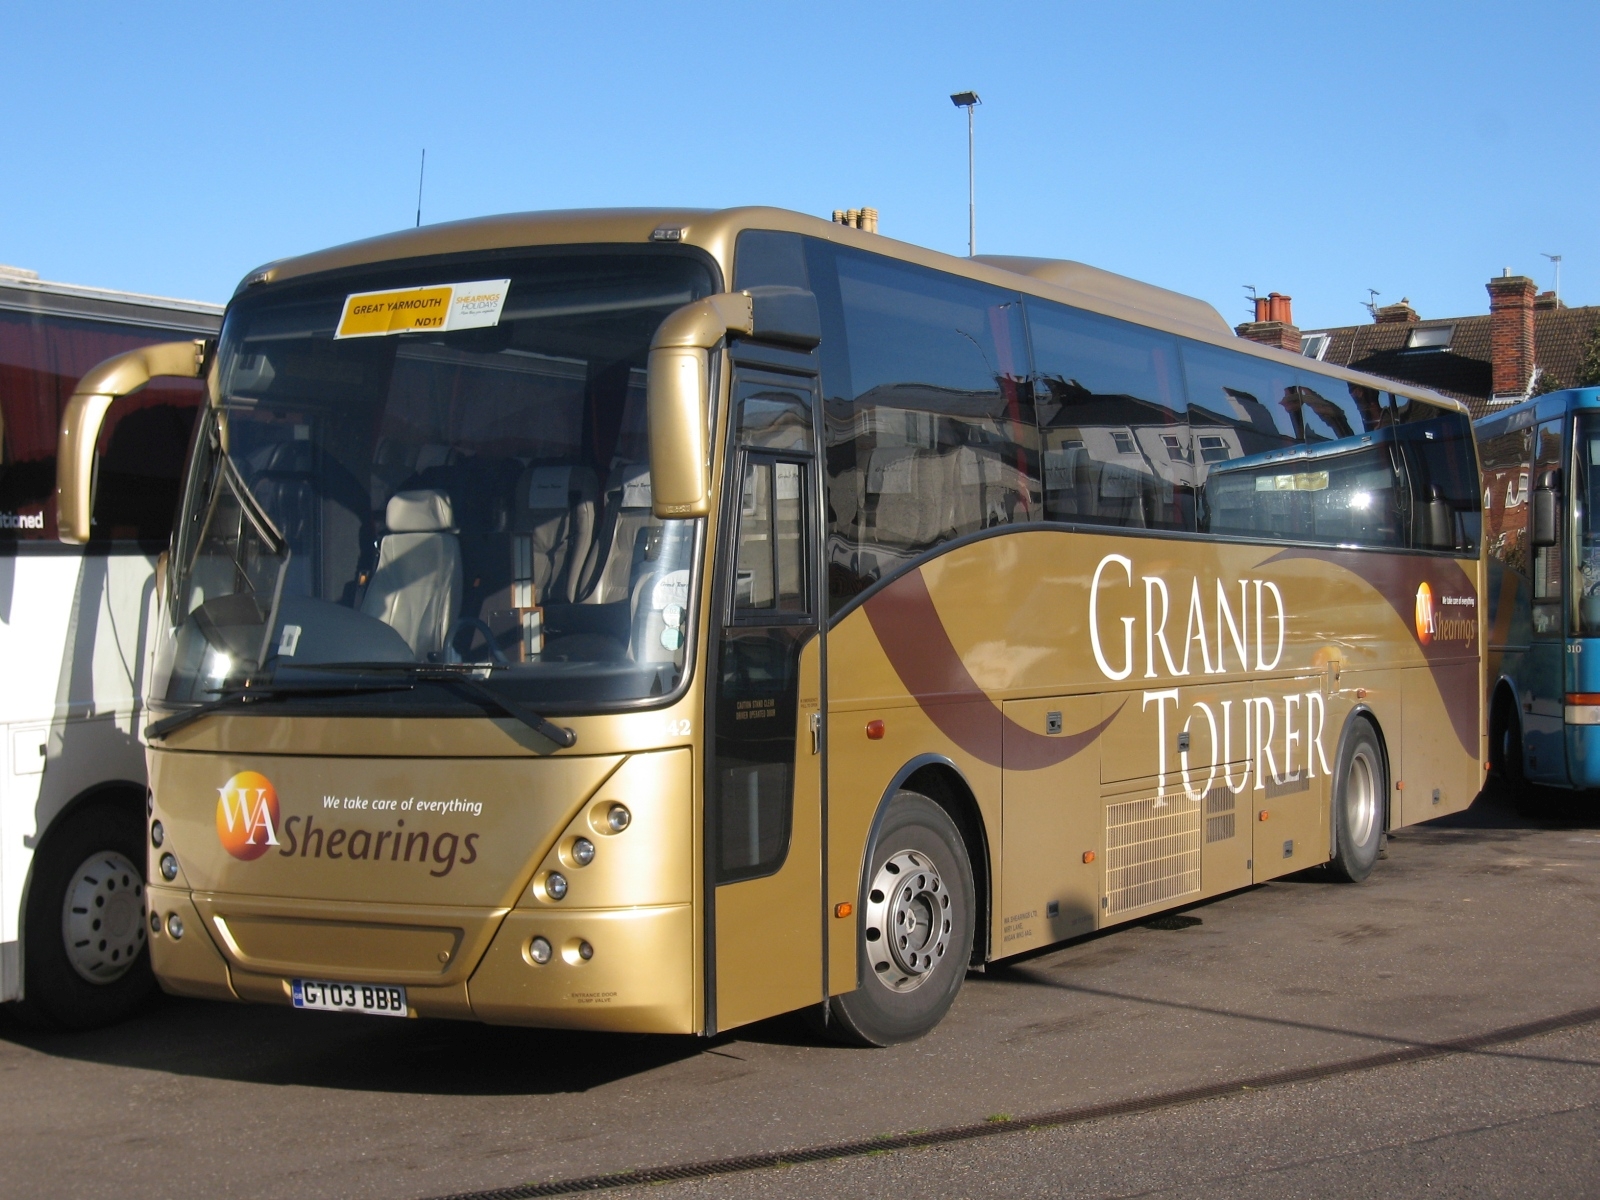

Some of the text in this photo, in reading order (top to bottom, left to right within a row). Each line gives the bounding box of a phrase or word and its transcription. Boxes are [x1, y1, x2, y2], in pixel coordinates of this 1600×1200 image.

[353, 298, 442, 315] GREAT YARMOUTH
[455, 293, 500, 304] SHEARINGS
[461, 301, 498, 310] HOLIDAYS
[414, 317, 443, 327] ND11
[1089, 553, 1285, 681] GRAND
[1415, 593, 1435, 634] WA
[1433, 611, 1475, 649] Shearings
[1566, 644, 1582, 654] 310
[1142, 688, 1332, 808] TOURER
[216, 787, 280, 846] WA
[323, 795, 483, 816] We take care of everything
[279, 815, 480, 878] Shearings
[303, 981, 402, 1011] GT03 BBB
